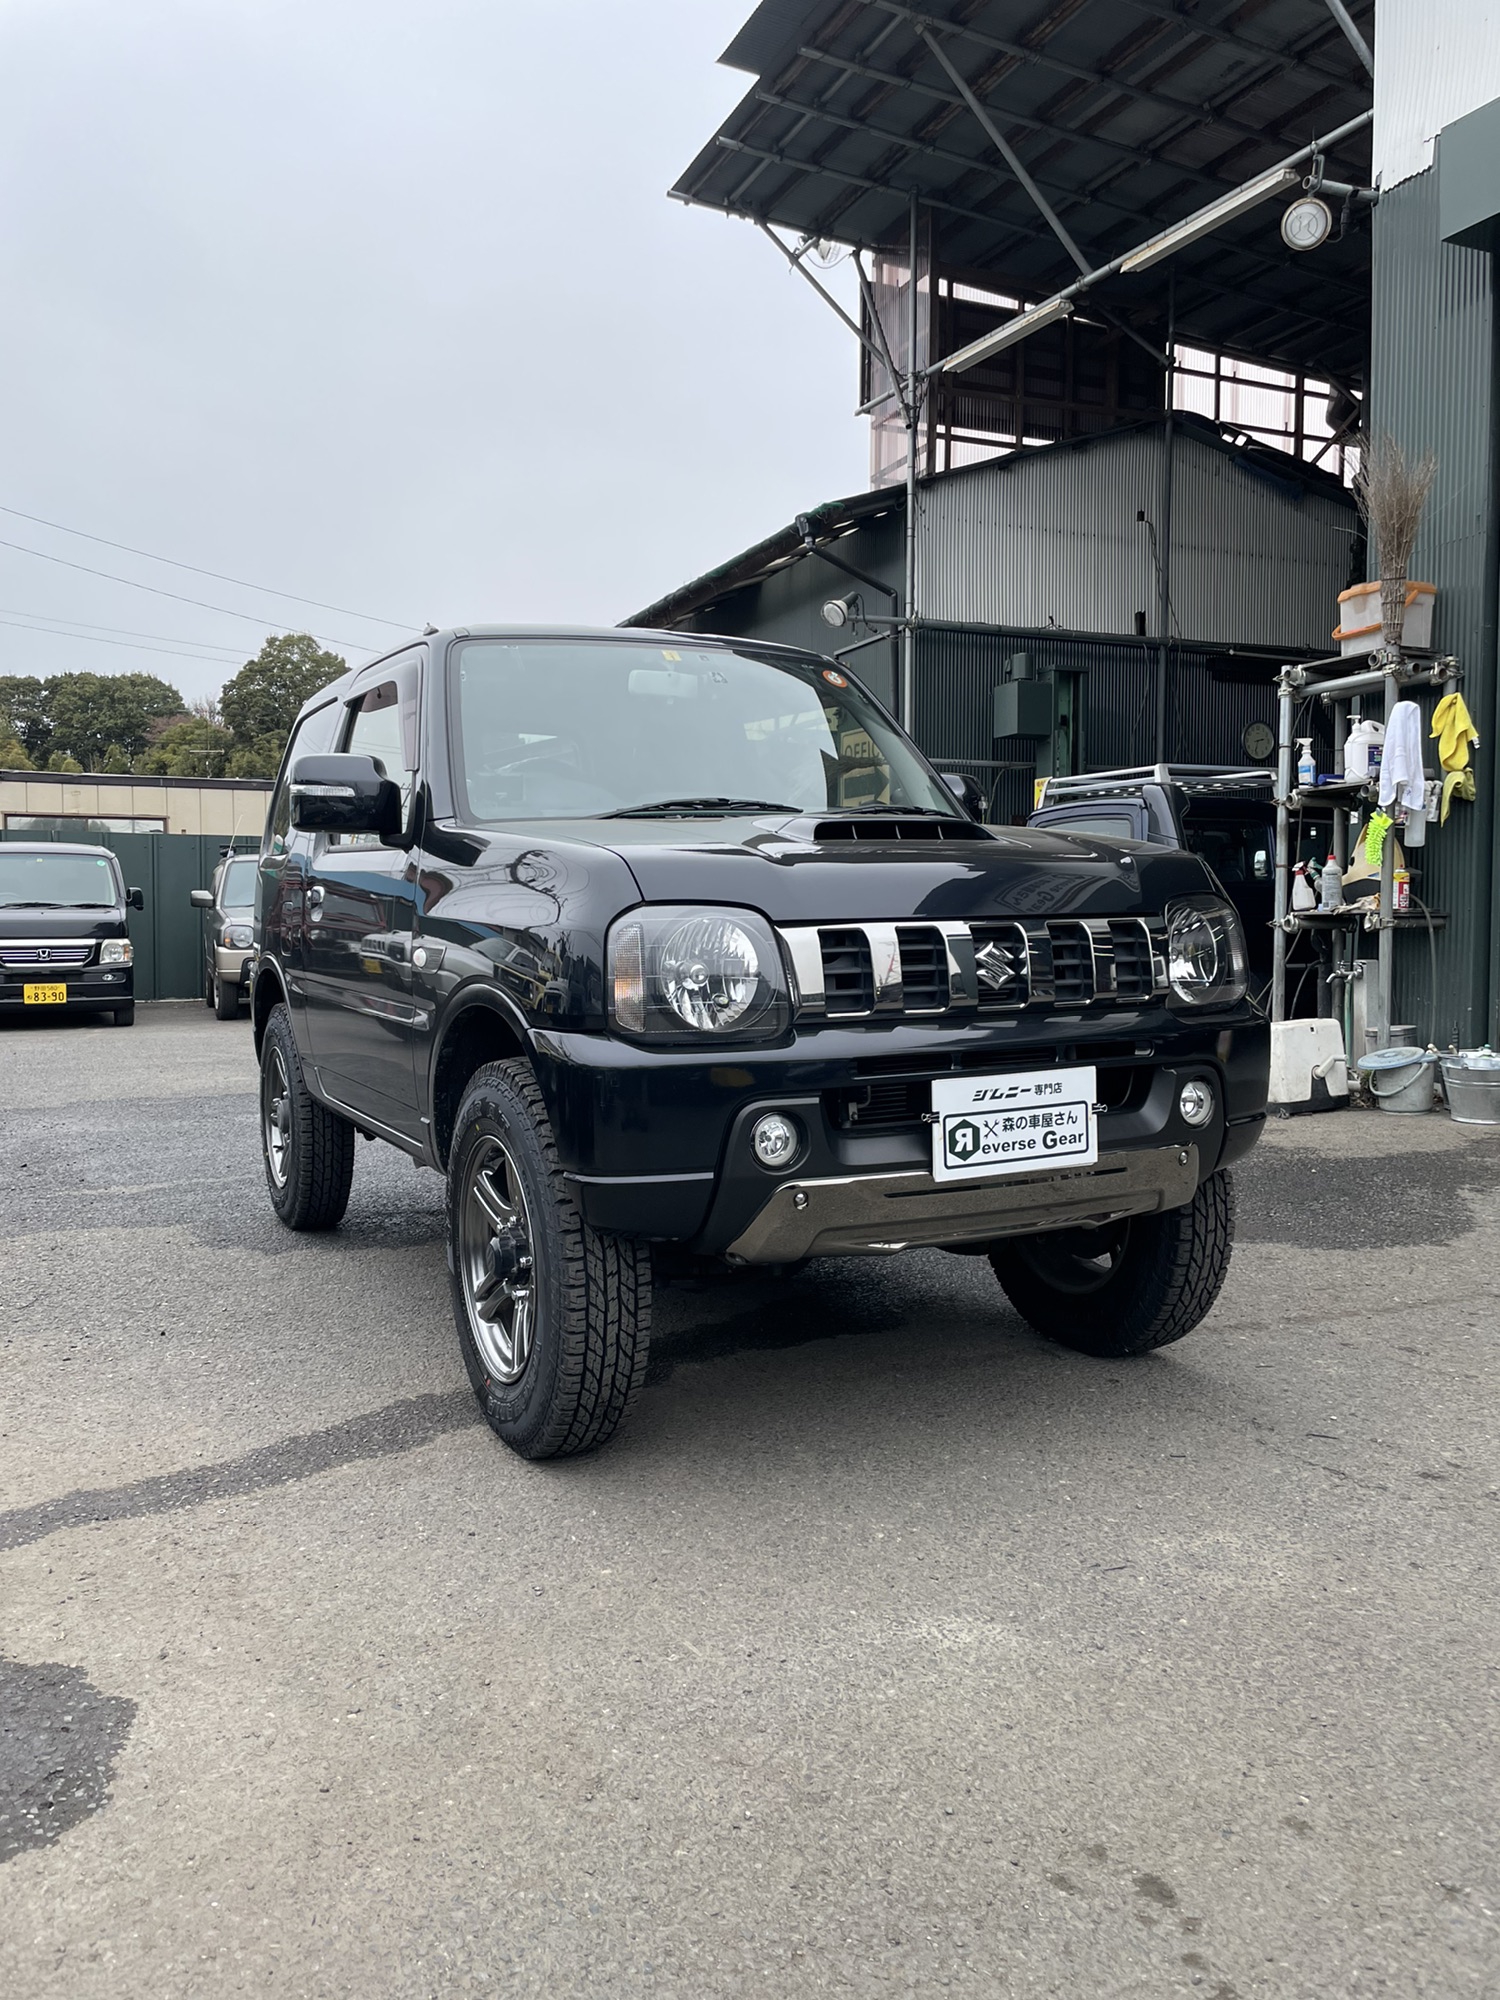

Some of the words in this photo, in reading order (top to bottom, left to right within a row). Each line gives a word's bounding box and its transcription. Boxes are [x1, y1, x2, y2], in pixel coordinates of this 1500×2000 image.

[33, 991, 65, 1002] 83-90
[1001, 1110, 1078, 1132] 森の車屋さん
[1042, 1130, 1085, 1150] Gear
